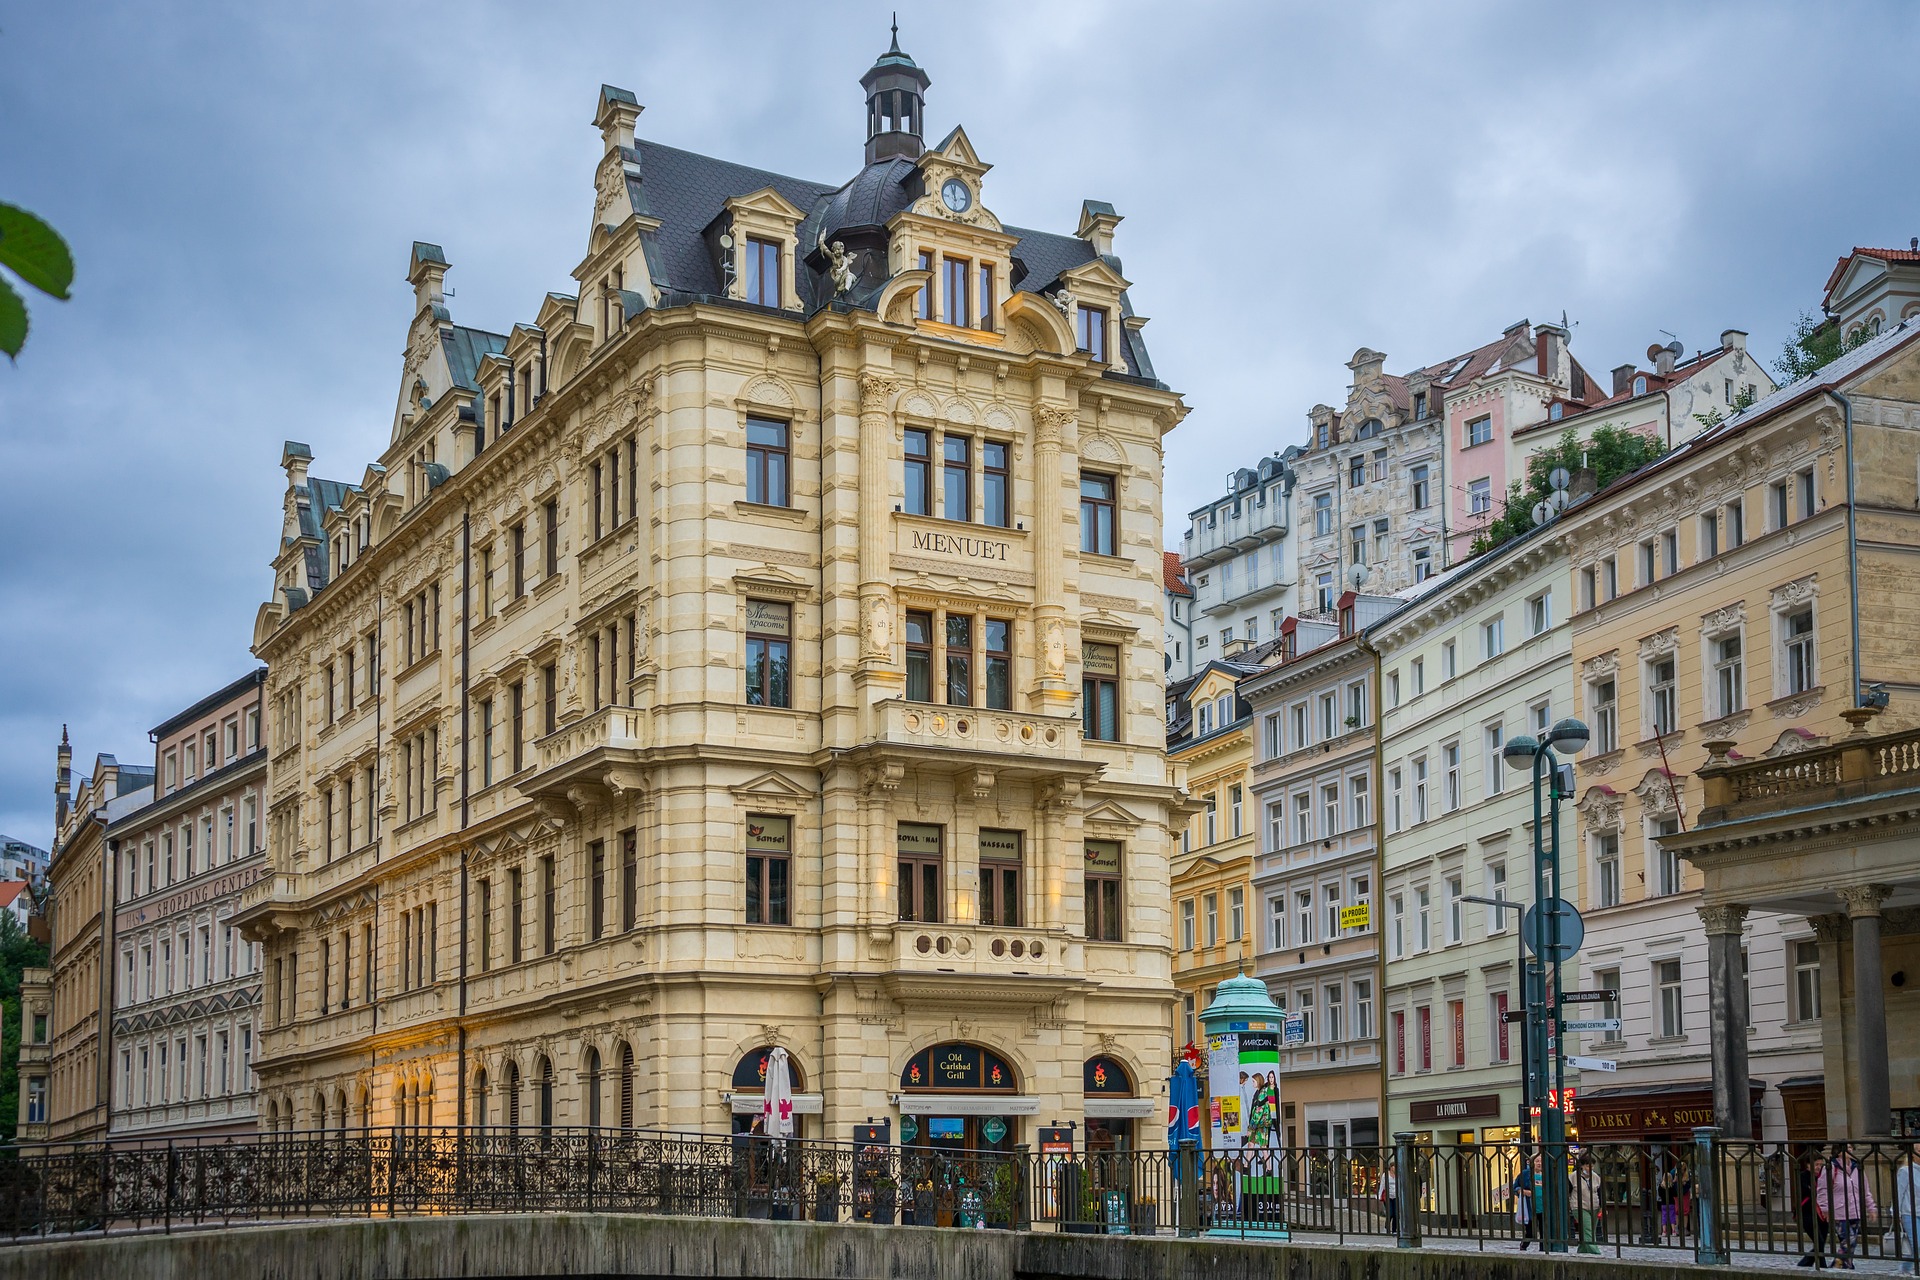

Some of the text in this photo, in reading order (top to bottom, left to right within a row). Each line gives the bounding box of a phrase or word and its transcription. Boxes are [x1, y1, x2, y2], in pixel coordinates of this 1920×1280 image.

[912, 530, 1010, 561] MENUET
[750, 619, 785, 630] красоты
[1083, 660, 1114, 670] красоты
[756, 835, 785, 844] sansei
[981, 840, 1016, 850] MASSAGE
[1092, 859, 1117, 867] sansei
[157, 886, 208, 918] SHOPPING
[213, 868, 259, 897] CENTER
[1567, 1021, 1588, 1030] OBCHODNÍ
[948, 1053, 962, 1062] Old
[940, 1061, 971, 1071] Carlsbad
[1568, 1058, 1577, 1066] WC
[1602, 1062, 1610, 1070] 100
[946, 1071, 965, 1080] Grill
[1436, 1102, 1468, 1117] LA FORTUNA
[1590, 1109, 1715, 1128] DÁRKY SOUVE
